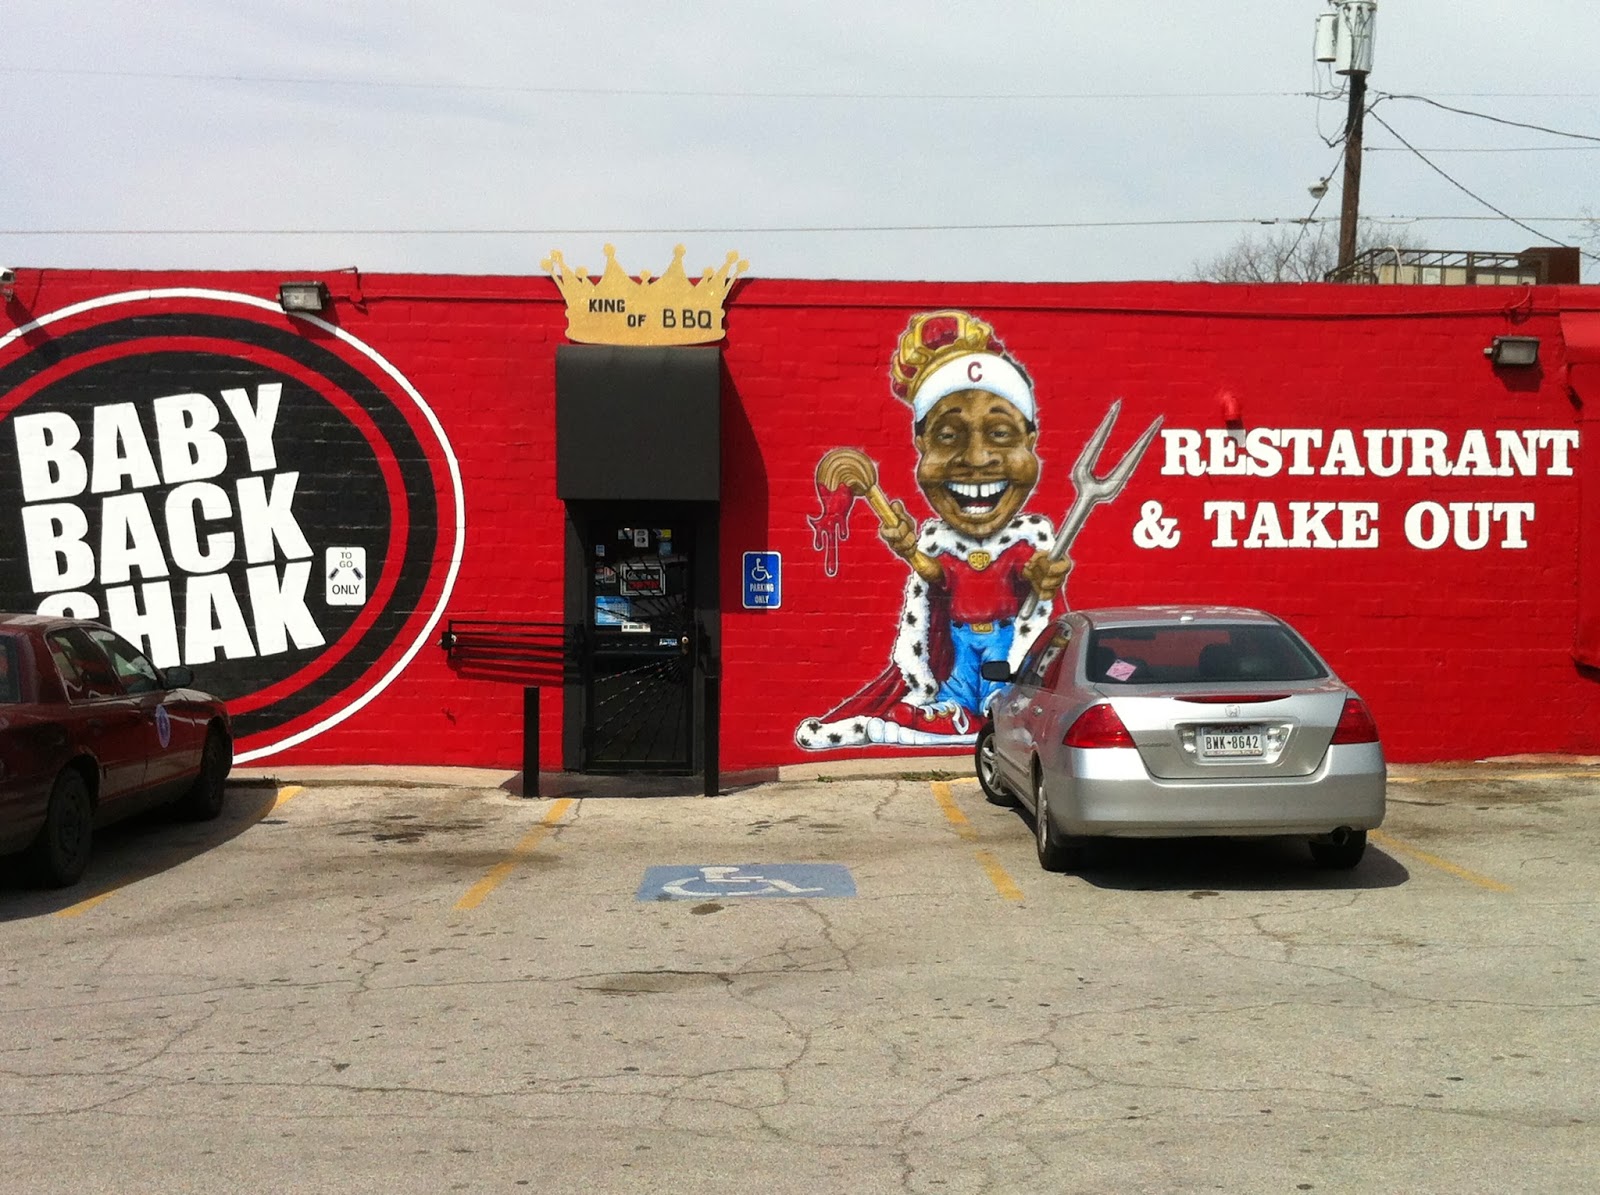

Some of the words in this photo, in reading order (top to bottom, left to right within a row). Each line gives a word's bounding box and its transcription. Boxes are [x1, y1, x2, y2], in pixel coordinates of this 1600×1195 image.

[588, 299, 626, 313] KING
[627, 314, 647, 328] OF
[967, 361, 983, 383] C
[14, 382, 283, 502] BABY
[1160, 427, 1580, 477] RESTAURANT
[21, 471, 315, 593] BACK
[1132, 500, 1181, 550] &
[1203, 501, 1380, 549] TAKE
[1403, 501, 1535, 550] OUT
[339, 560, 354, 569] GO
[340, 551, 353, 560] TO
[331, 584, 360, 595] ONLY
[749, 583, 775, 593] PARKING
[754, 595, 770, 604] ONLY
